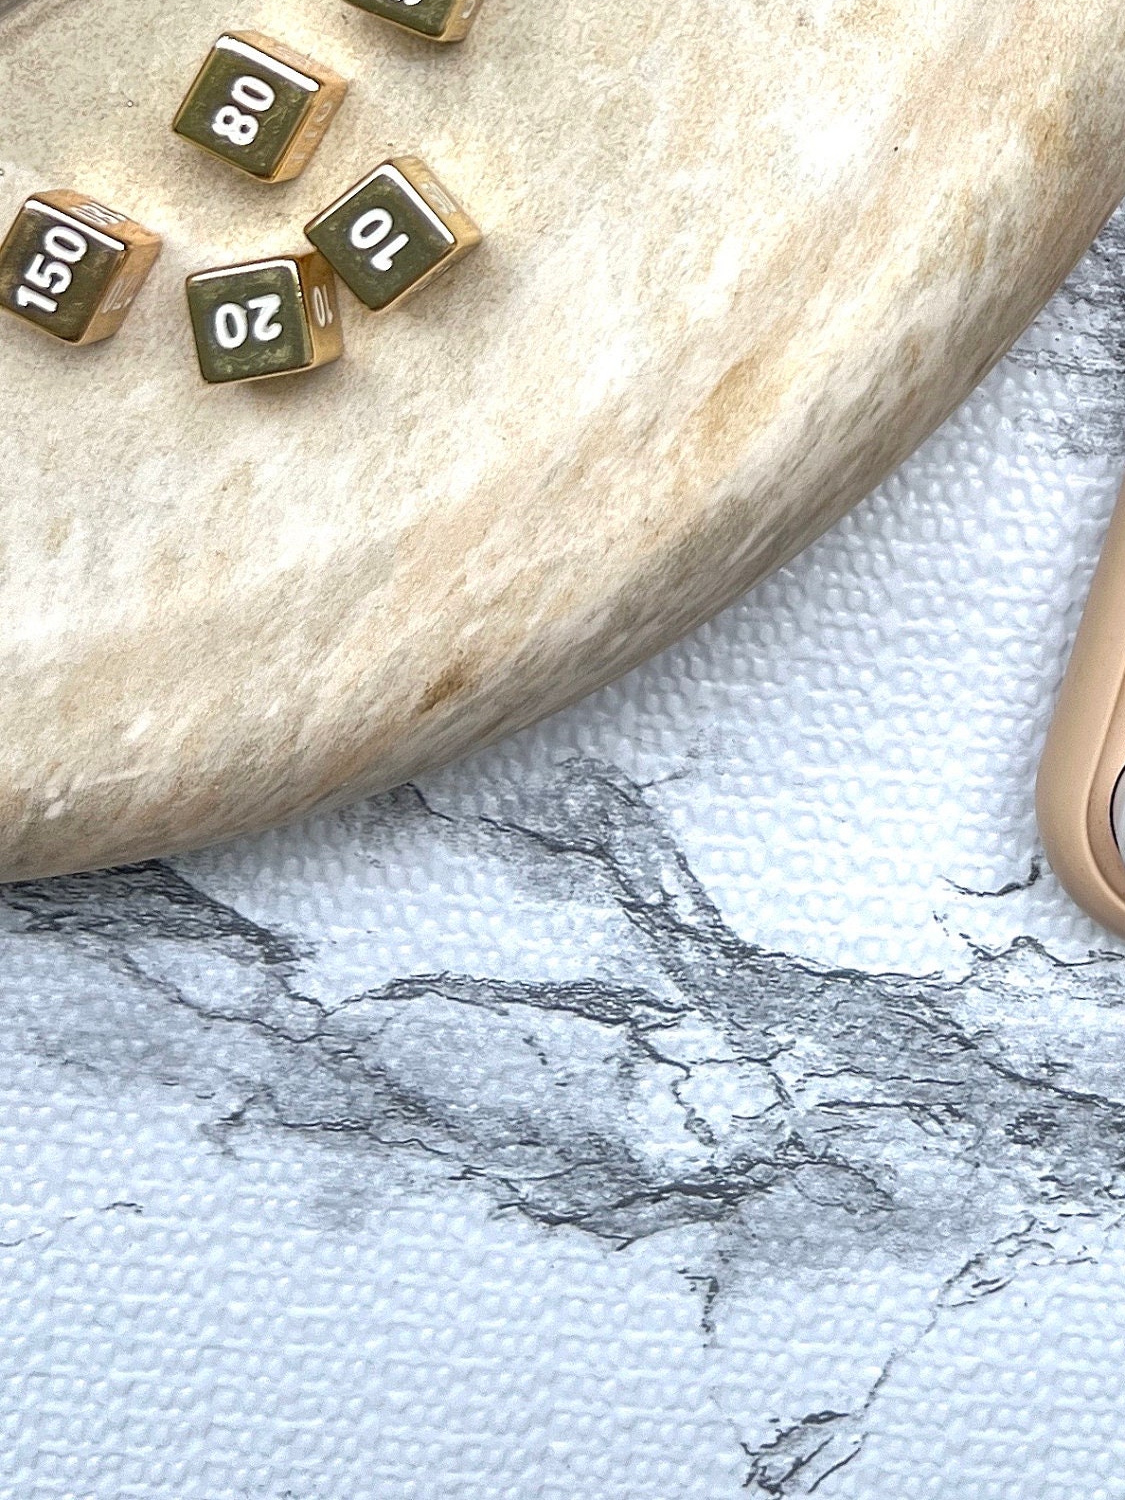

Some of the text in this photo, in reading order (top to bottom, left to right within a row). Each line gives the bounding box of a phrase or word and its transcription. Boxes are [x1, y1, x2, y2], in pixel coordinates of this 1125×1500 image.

[212, 77, 274, 145] 80
[17, 225, 88, 313] 150
[351, 209, 408, 271] 10
[215, 294, 281, 348] 20
